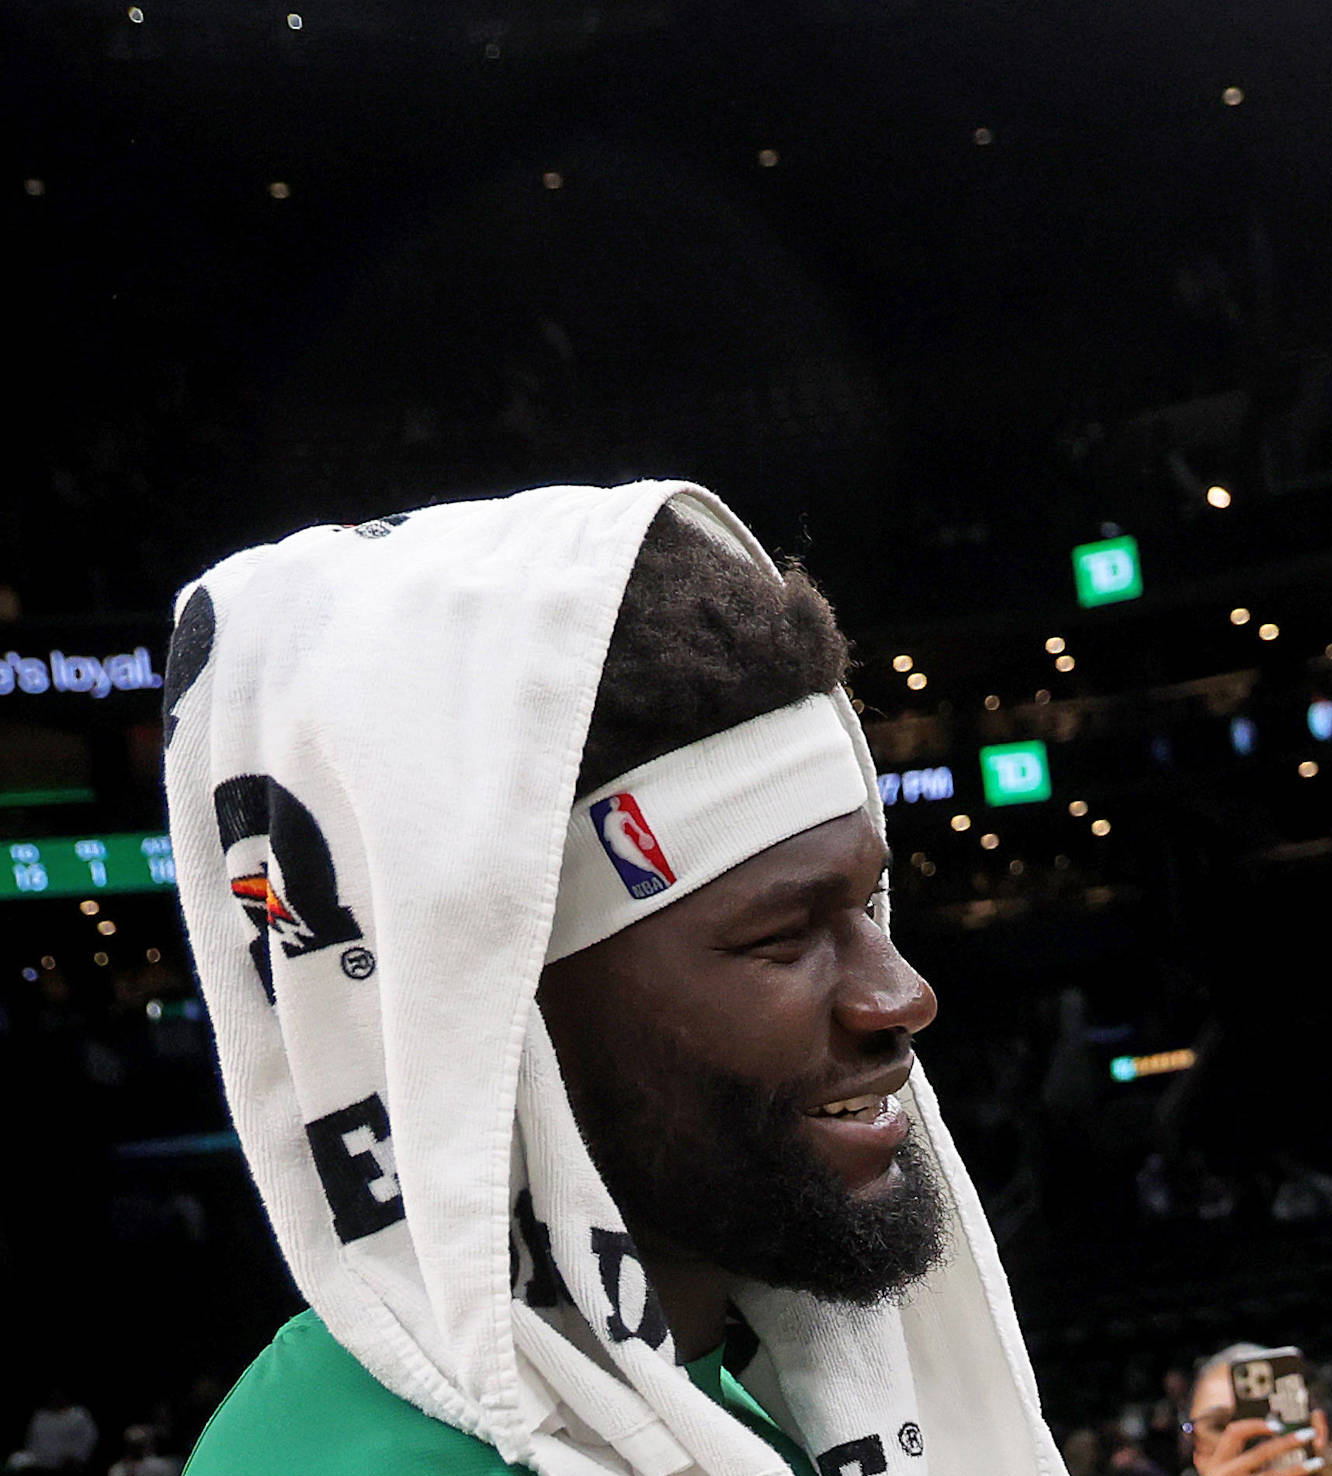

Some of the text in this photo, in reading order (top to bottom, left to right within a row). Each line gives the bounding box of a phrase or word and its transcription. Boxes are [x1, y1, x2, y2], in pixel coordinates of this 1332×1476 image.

[1079, 548, 1134, 596] TD
[50, 646, 163, 699] loyal.
[988, 751, 1043, 794] TD
[631, 876, 664, 898] NBA
